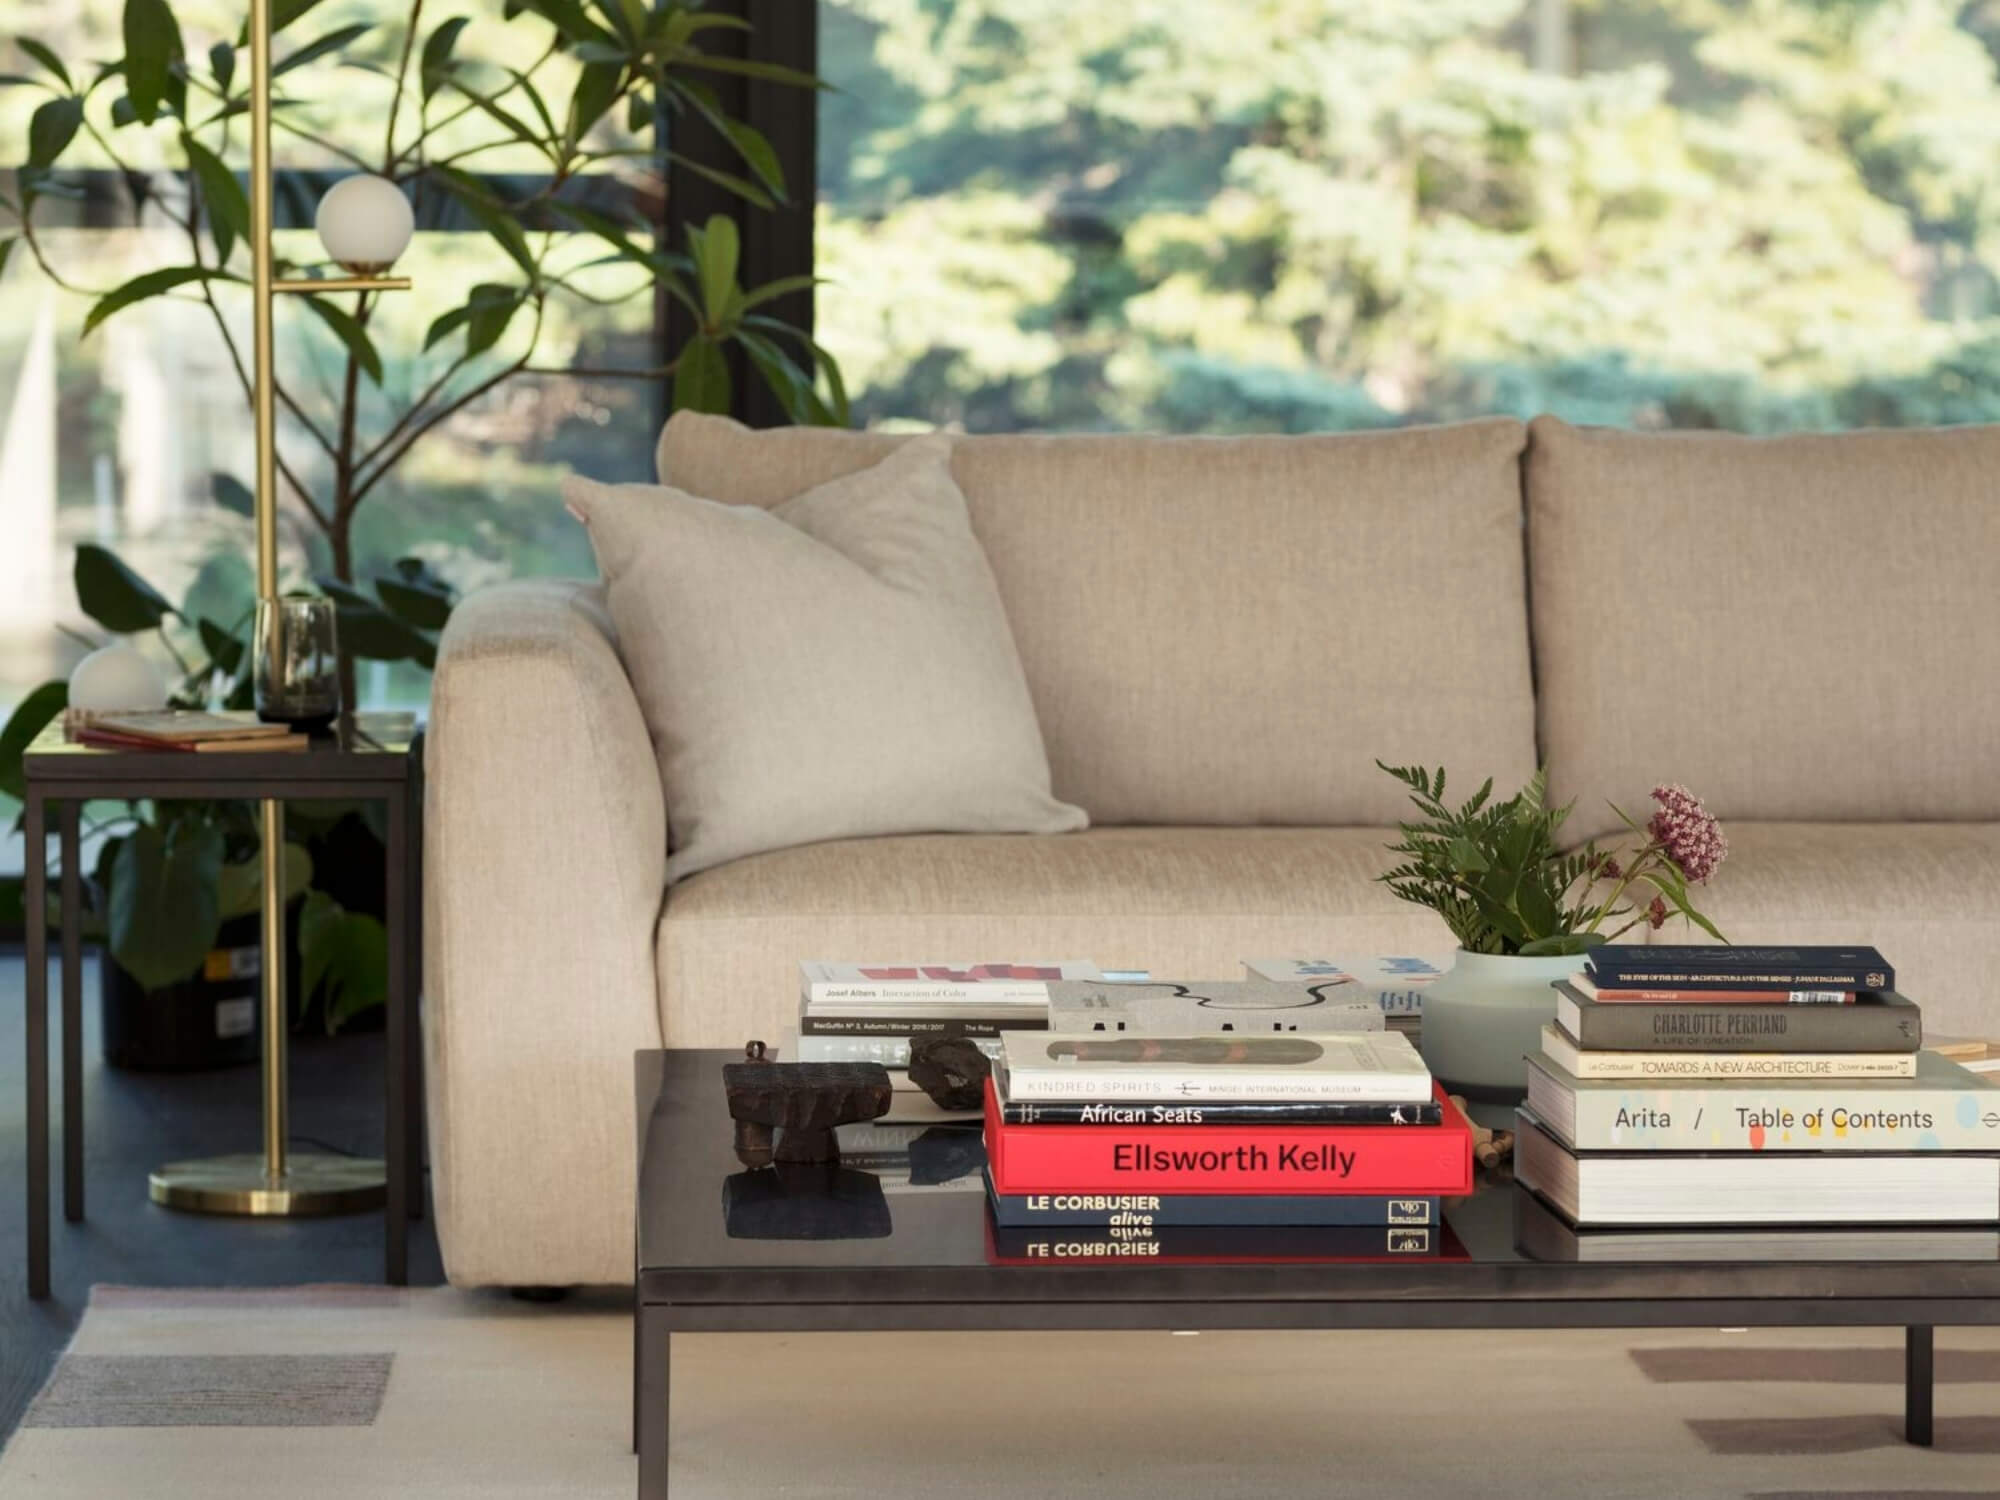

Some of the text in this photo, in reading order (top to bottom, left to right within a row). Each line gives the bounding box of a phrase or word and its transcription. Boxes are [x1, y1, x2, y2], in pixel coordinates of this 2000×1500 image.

[826, 989, 967, 998] Josef Albers Interaction of Color
[1654, 1014, 1787, 1034] CHARLOTTE PERRIAND
[1641, 1062, 1832, 1073] TOWARDS A NEW ARCHITECTURE
[1027, 1081, 1161, 1093] KINDRED SPIRITS
[1209, 1085, 1241, 1093] MINGEI
[1246, 1085, 1317, 1094] INTERNATIONAL
[1321, 1085, 1361, 1094] MUSEUM
[1080, 1104, 1202, 1124] African Seats
[1615, 1108, 1671, 1129] Arita
[1736, 1108, 1795, 1129] Table
[1802, 1108, 1824, 1129] of
[1831, 1108, 1933, 1129] Contents
[1113, 1144, 1356, 1179] Ellsworth Kelly
[1027, 1195, 1160, 1210] LE CORBUSIER
[1109, 1212, 1153, 1226] alive
